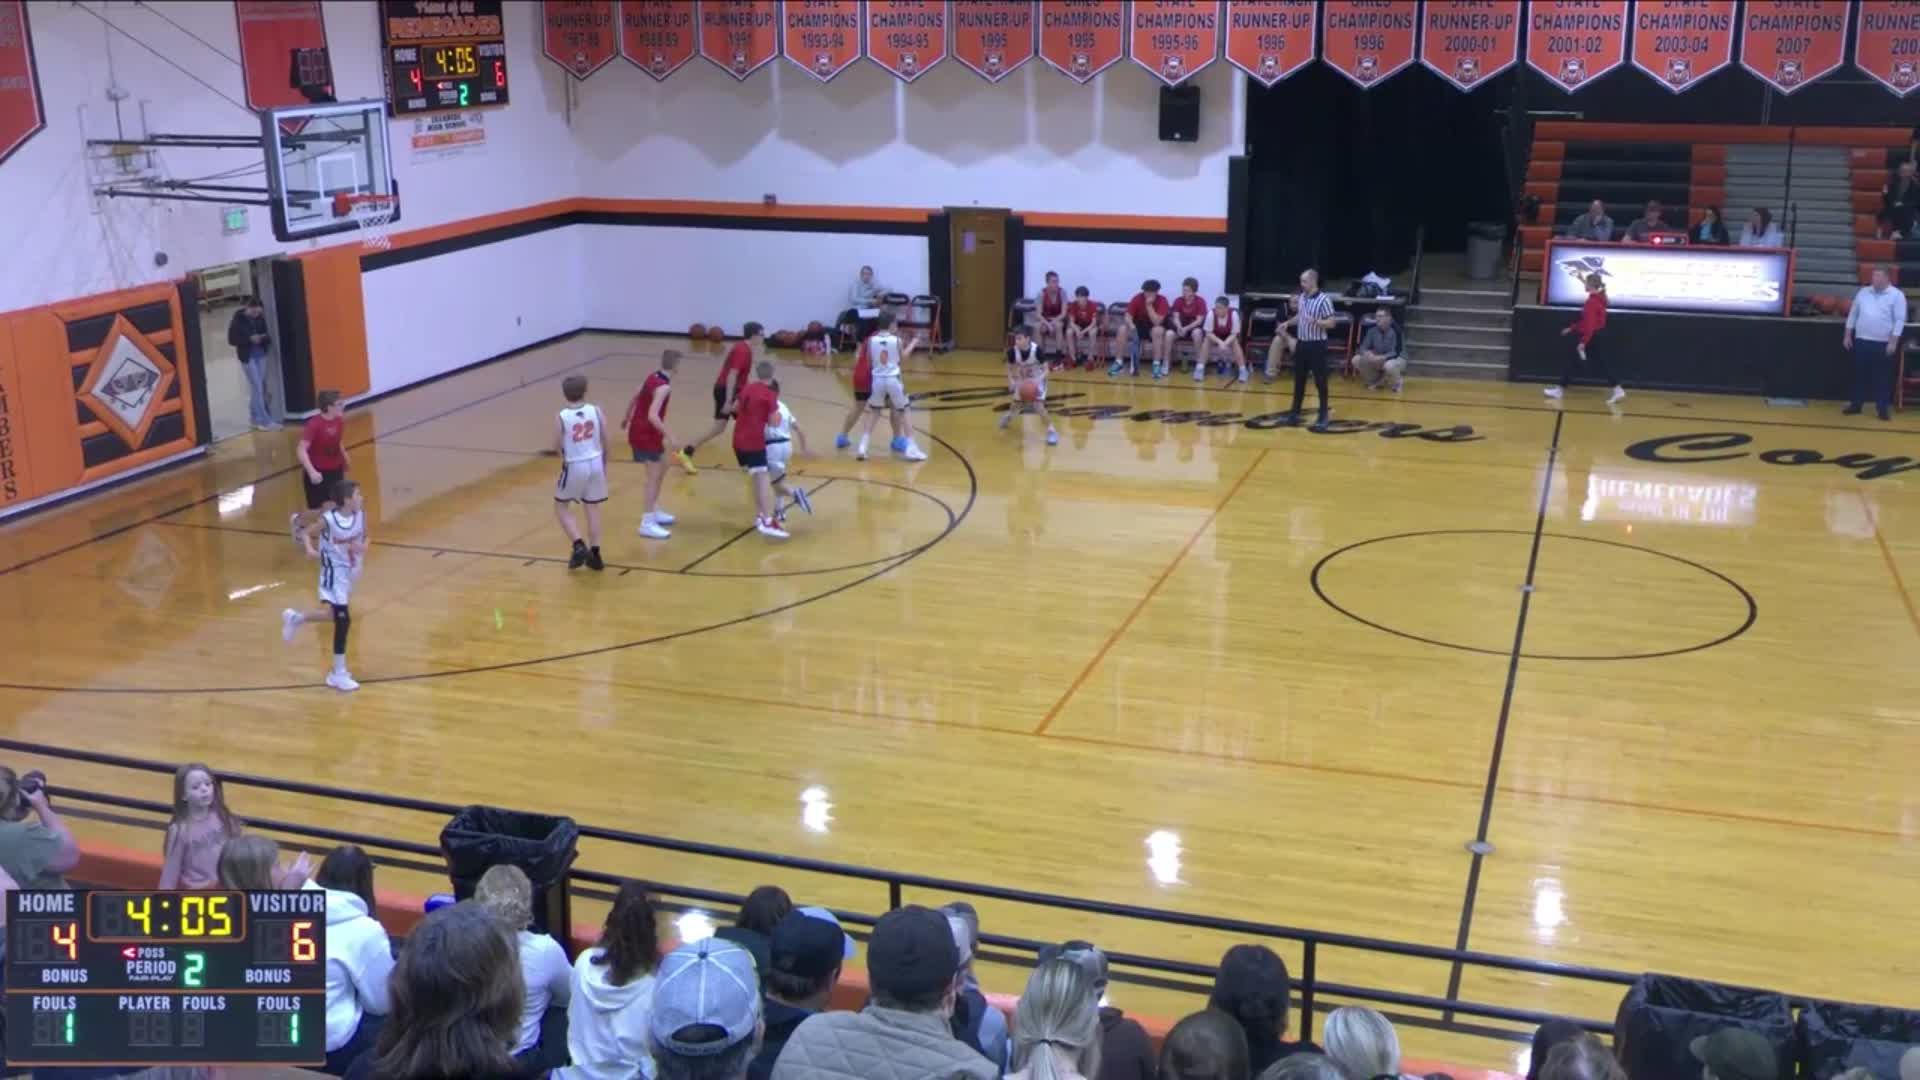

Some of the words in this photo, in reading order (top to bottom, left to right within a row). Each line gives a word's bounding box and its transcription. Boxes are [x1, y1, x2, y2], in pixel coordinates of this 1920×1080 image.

[788, 14, 857, 28] CHAMPIONS
[871, 13, 944, 28] CHAMPIONS
[1045, 13, 1121, 28] CHAMPIONS
[1136, 13, 1216, 29] CHAMPIONS
[1328, 14, 1412, 29] CHAMPIONS
[1430, 14, 1514, 30] RUNNER-UP
[1533, 15, 1621, 30] CHAMPIONS
[1639, 15, 1729, 30] CHAMPIONS
[1749, 15, 1843, 31] CHAMPIONS
[802, 33, 845, 48] 1993-94
[887, 33, 929, 48] 1994-95
[981, 33, 1008, 48] 1995
[1068, 33, 1096, 48] 1995
[1152, 34, 1199, 50] 1995-96
[1257, 34, 1286, 50] 1996
[1354, 35, 1385, 50] 1996
[1445, 36, 1497, 52] 2000-01
[1548, 36, 1602, 52] 2001-02
[1655, 36, 1710, 52] 2003-04
[1776, 38, 1812, 54] 2007
[435, 46, 476, 75] 4:05
[410, 67, 422, 94] 4
[494, 61, 506, 87] 6
[459, 83, 469, 107] 2
[572, 420, 594, 442] 22
